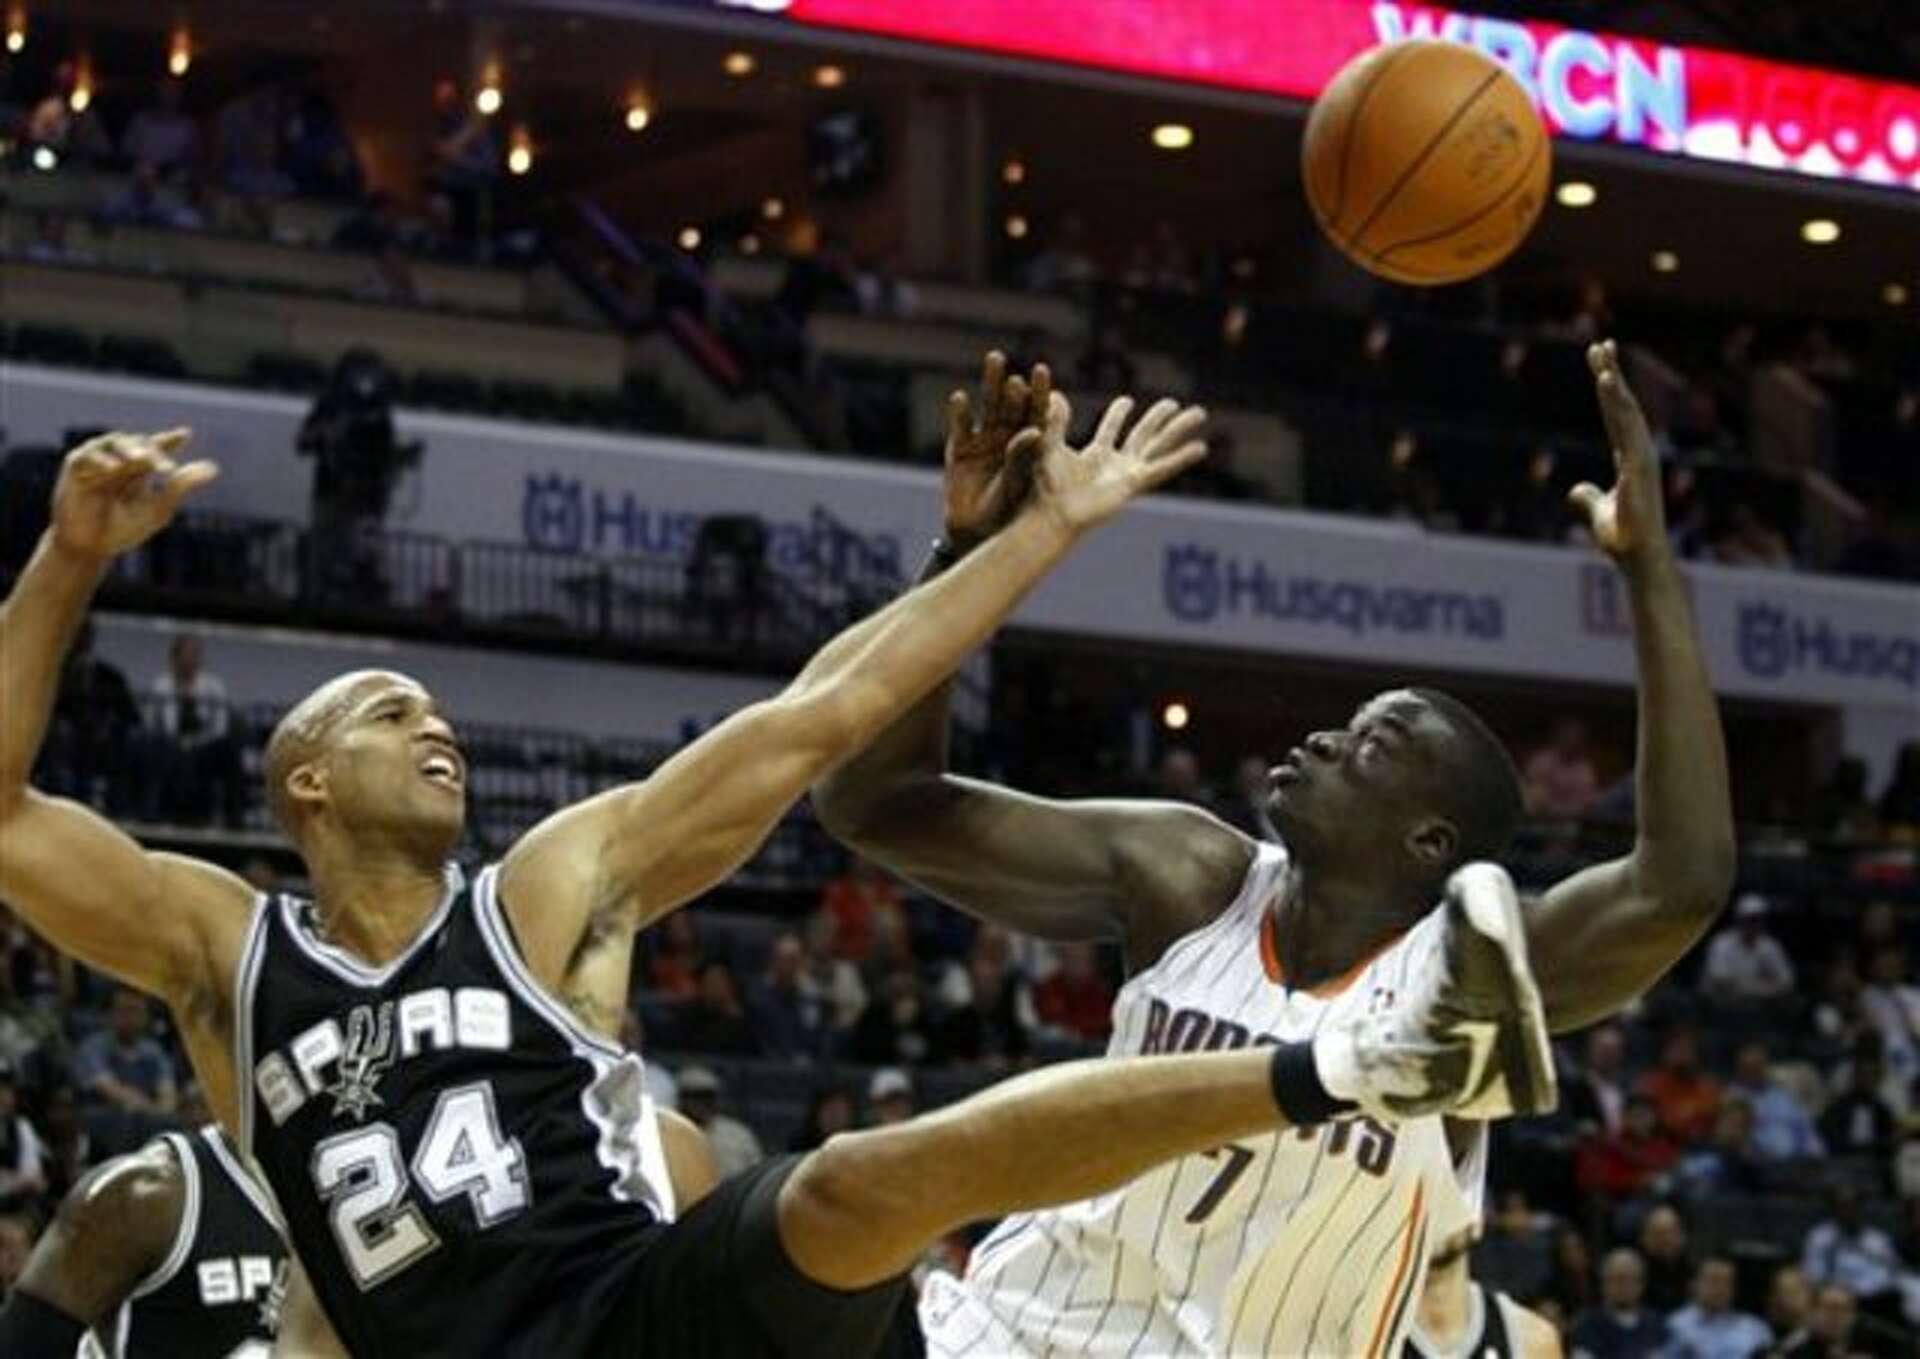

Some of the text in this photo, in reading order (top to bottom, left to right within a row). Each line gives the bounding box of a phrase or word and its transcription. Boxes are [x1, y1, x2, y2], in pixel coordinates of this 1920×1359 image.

[1227, 560, 1504, 640] Husqvarna
[309, 1079, 533, 1293] 24
[1184, 1142, 1255, 1225] 7
